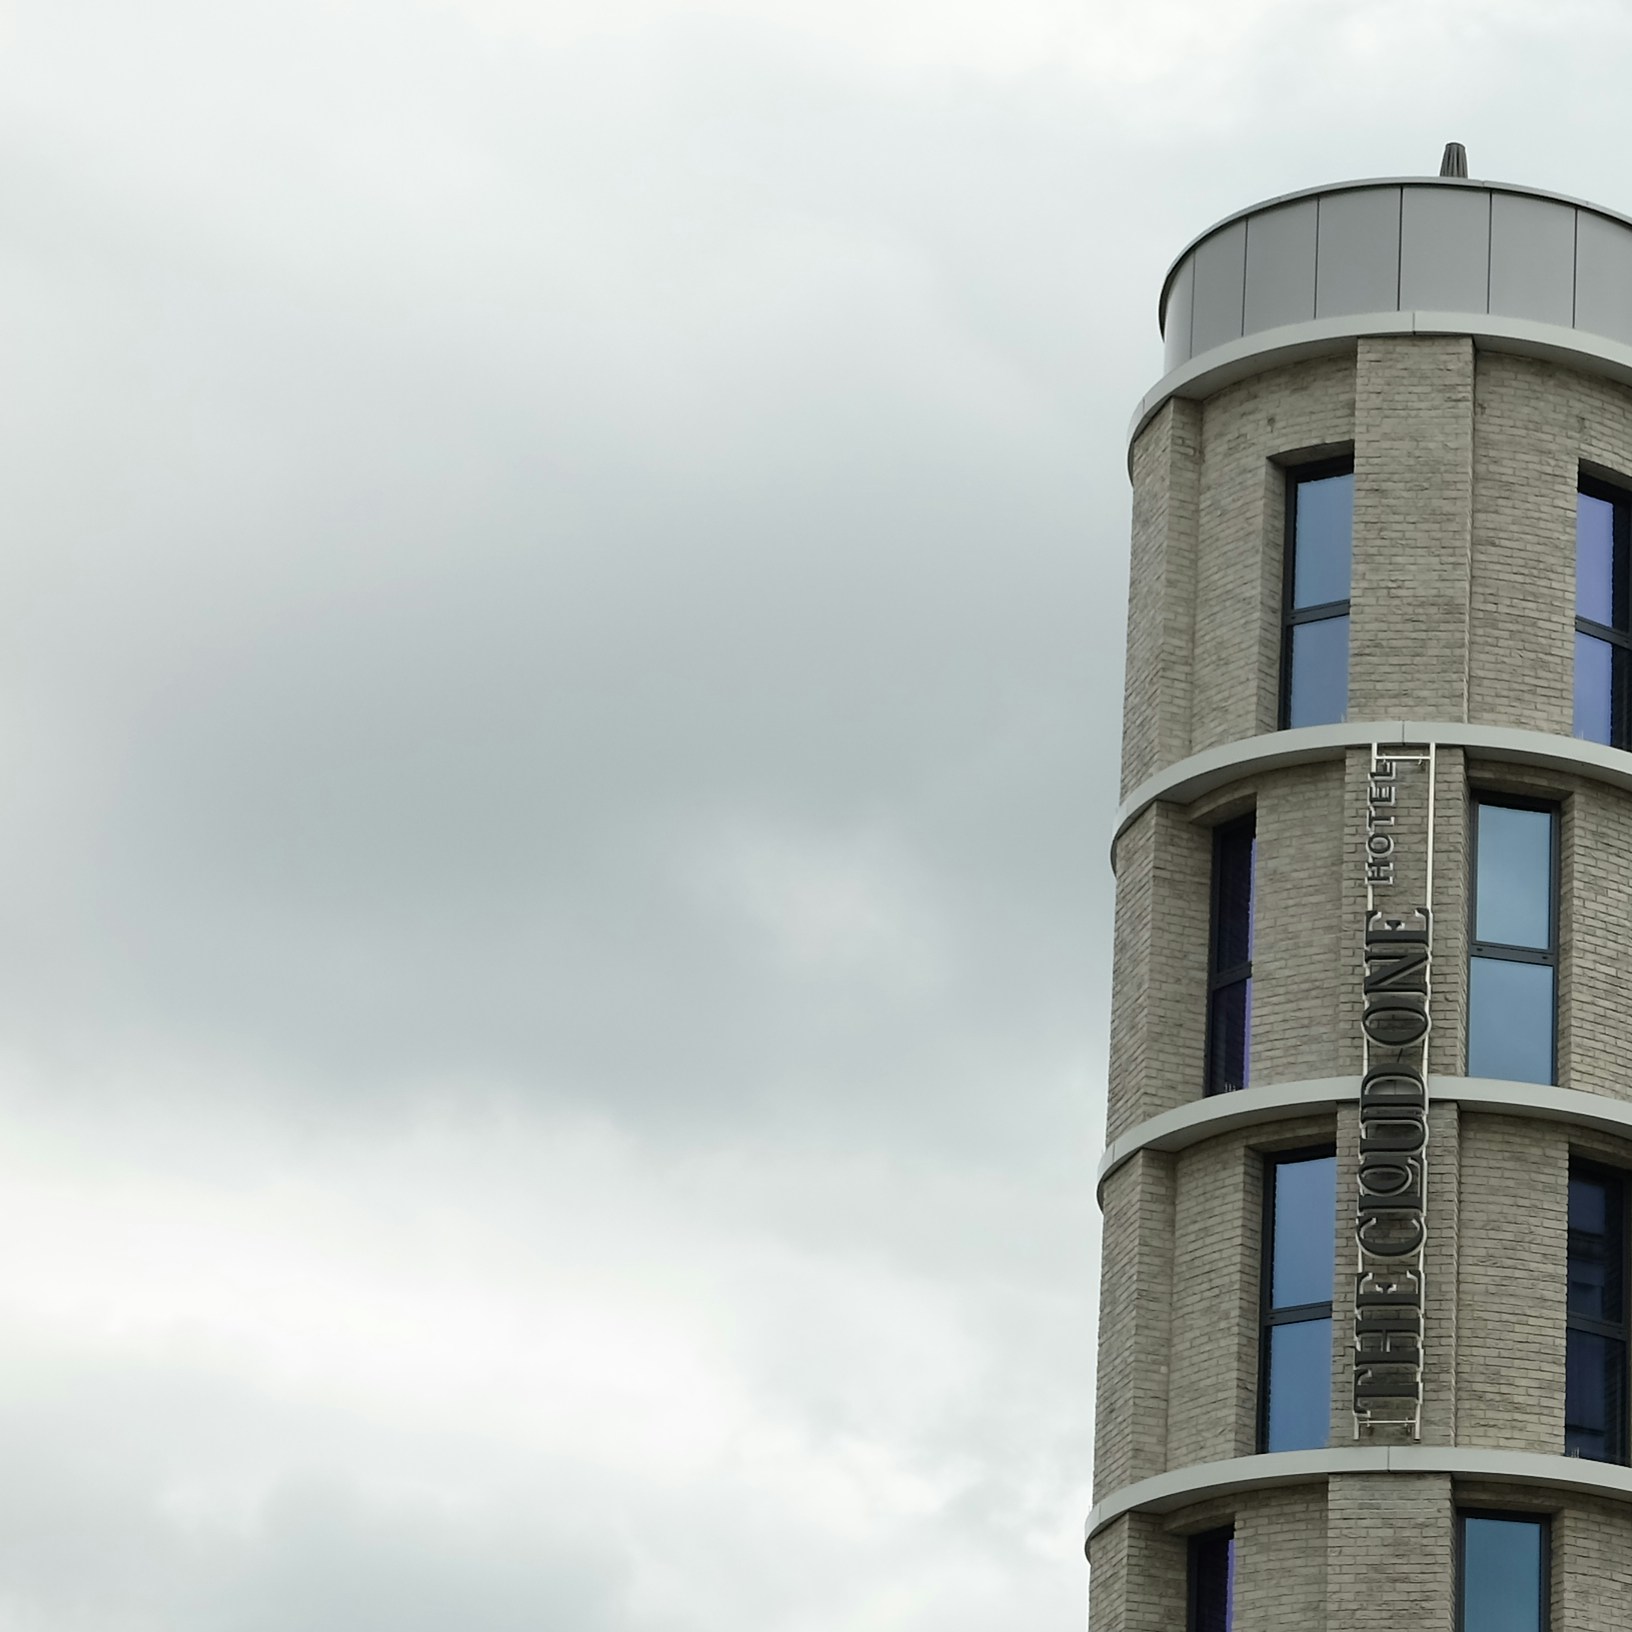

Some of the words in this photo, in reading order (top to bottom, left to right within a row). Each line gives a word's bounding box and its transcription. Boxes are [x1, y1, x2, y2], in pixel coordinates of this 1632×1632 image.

[1365, 761, 1396, 885] HOTEL
[1361, 908, 1432, 1049] ONE
[1356, 1063, 1429, 1258] CLOUD
[1353, 1270, 1425, 1418] THE
